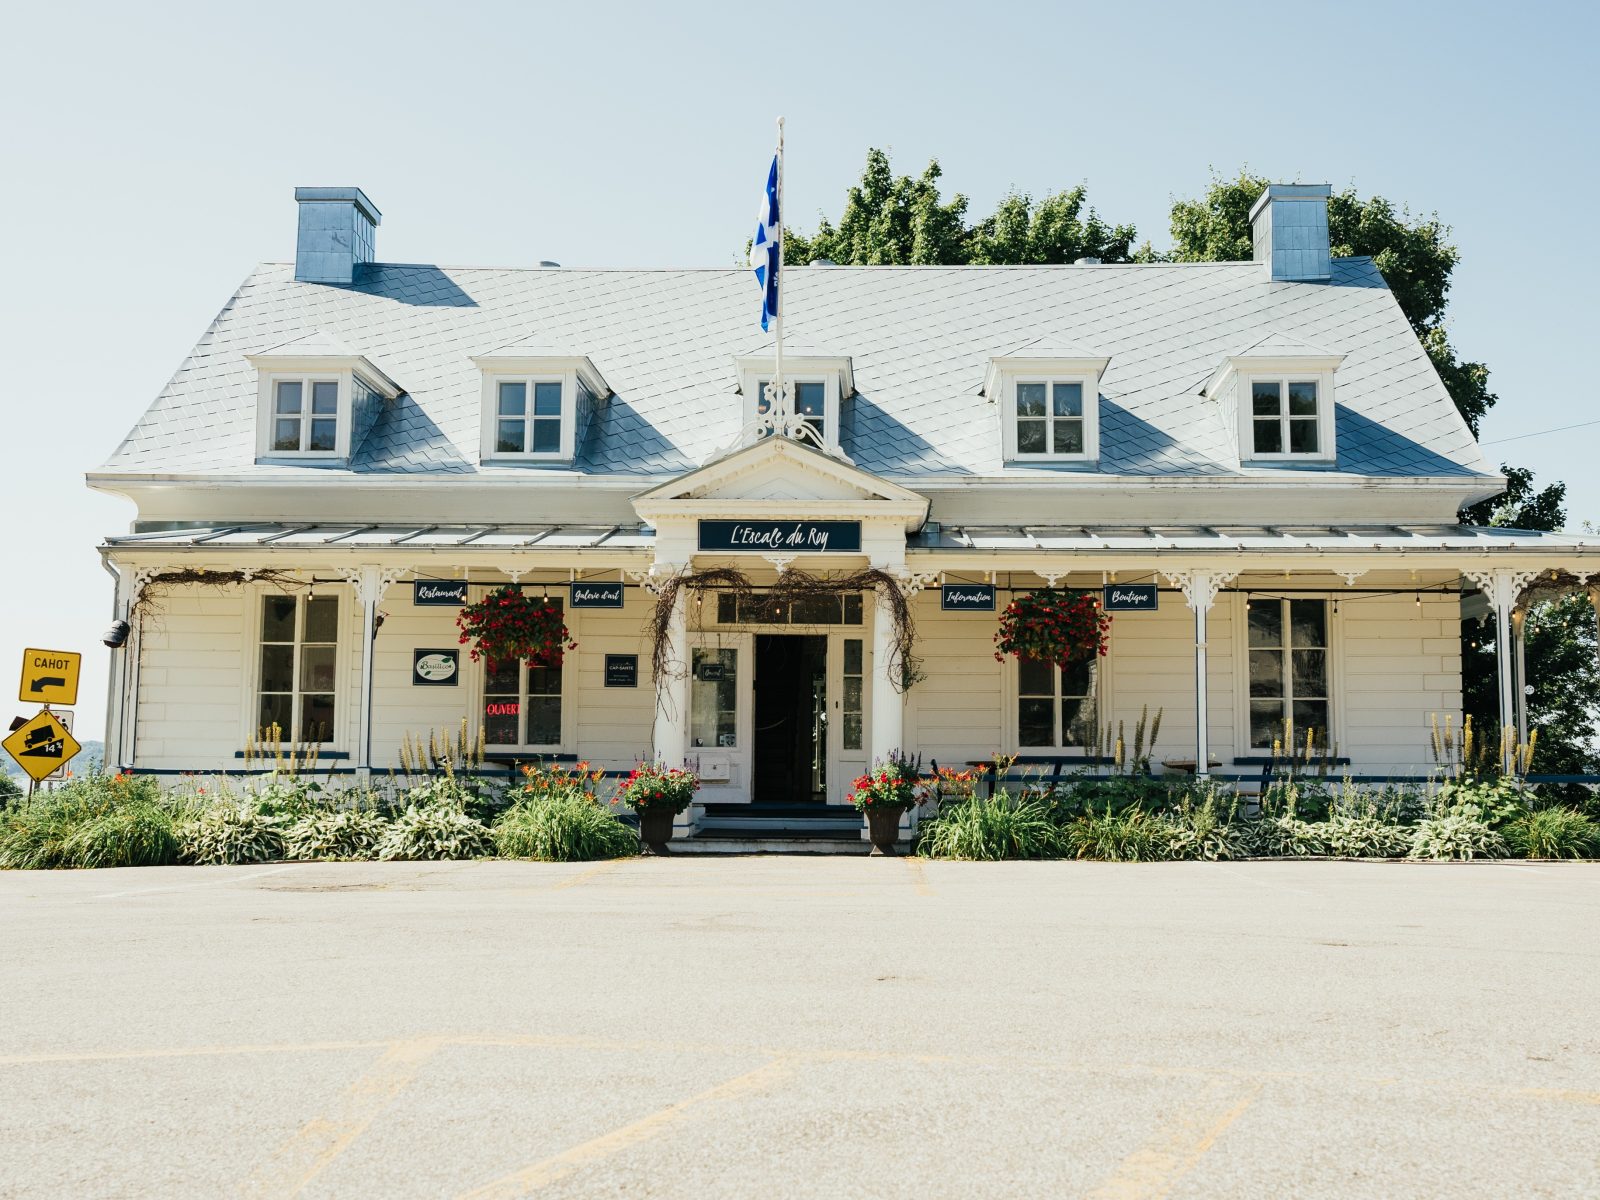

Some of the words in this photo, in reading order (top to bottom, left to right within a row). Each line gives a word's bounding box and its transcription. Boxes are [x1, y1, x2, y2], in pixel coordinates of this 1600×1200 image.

[730, 524, 784, 549] L'Escale
[786, 523, 805, 546] du
[807, 527, 830, 552] Roy
[418, 586, 463, 599] Restaurant
[574, 589, 600, 603] Galerie
[945, 591, 992, 604] Information
[1111, 590, 1149, 605] Boutique
[34, 657, 70, 670] CAHOT
[487, 703, 520, 715] OUVERT
